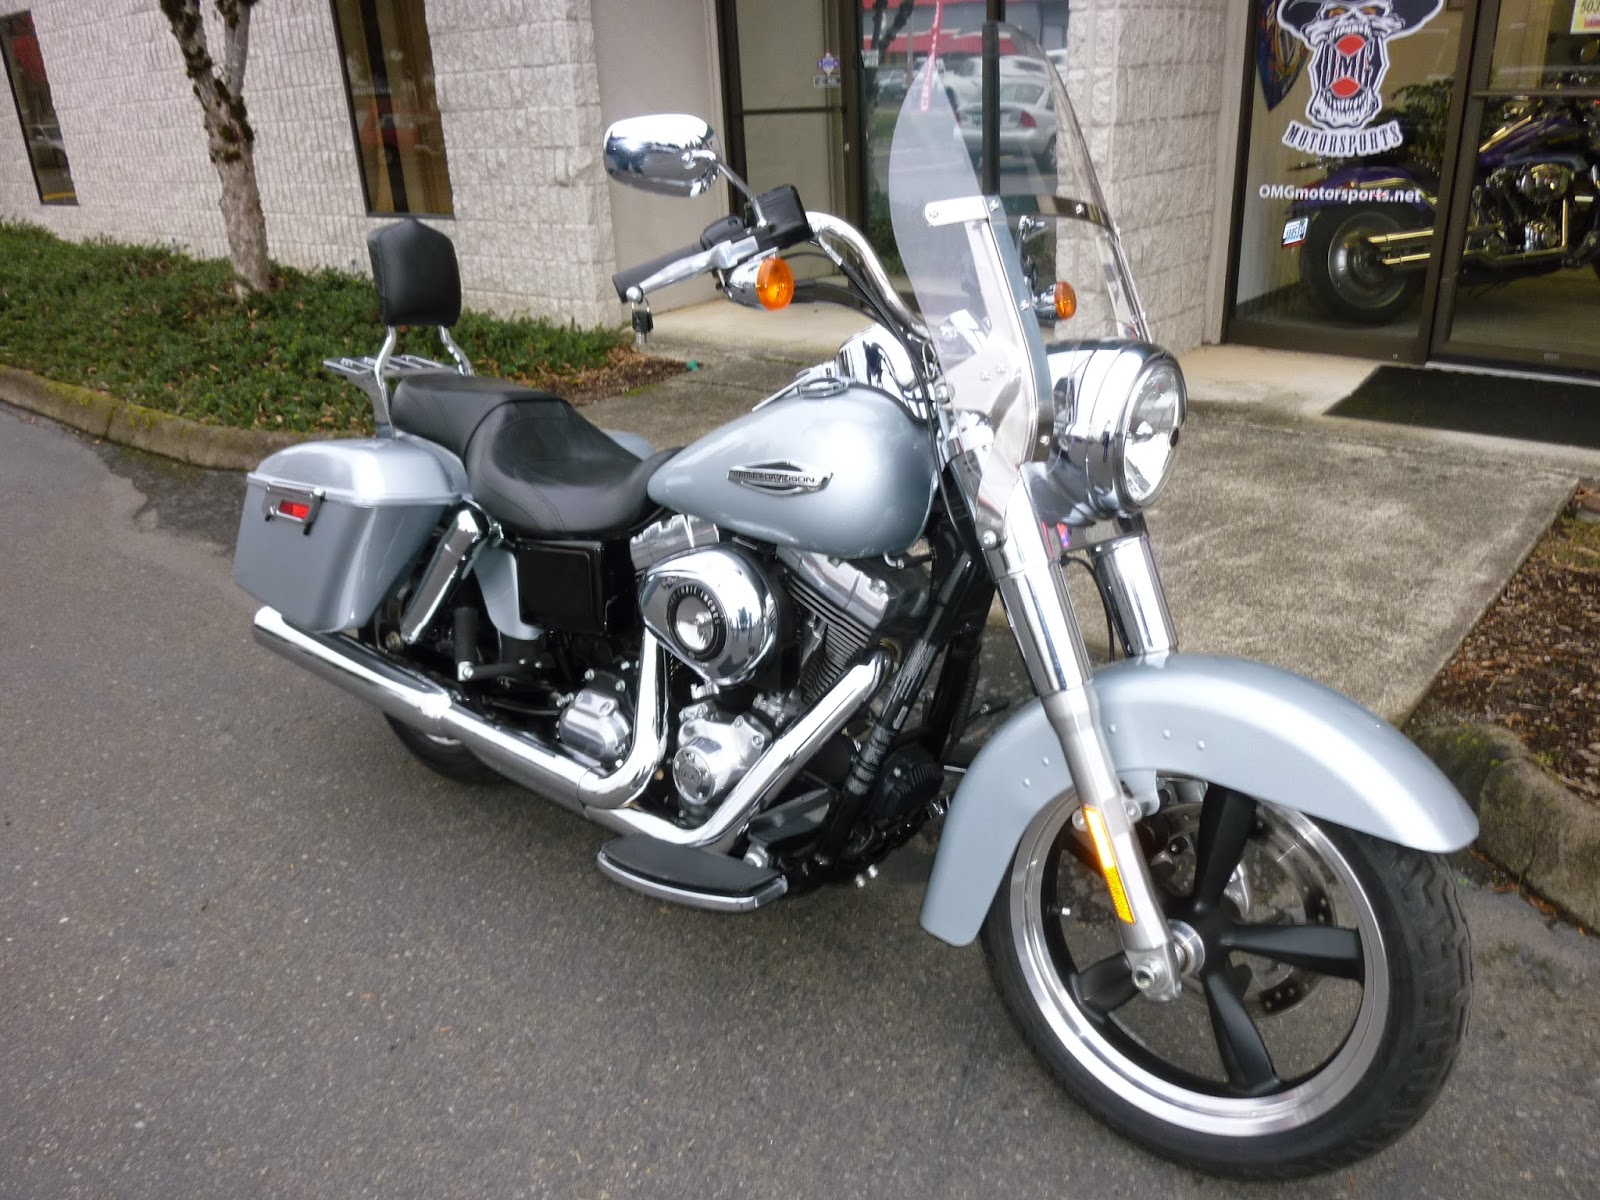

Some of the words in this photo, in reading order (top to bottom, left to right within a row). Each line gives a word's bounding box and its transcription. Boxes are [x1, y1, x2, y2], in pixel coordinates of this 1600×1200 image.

[1318, 38, 1375, 87] OMG
[1285, 123, 1400, 153] MOTORSPORTS
[1258, 184, 1422, 204] OMGmotorsports.net
